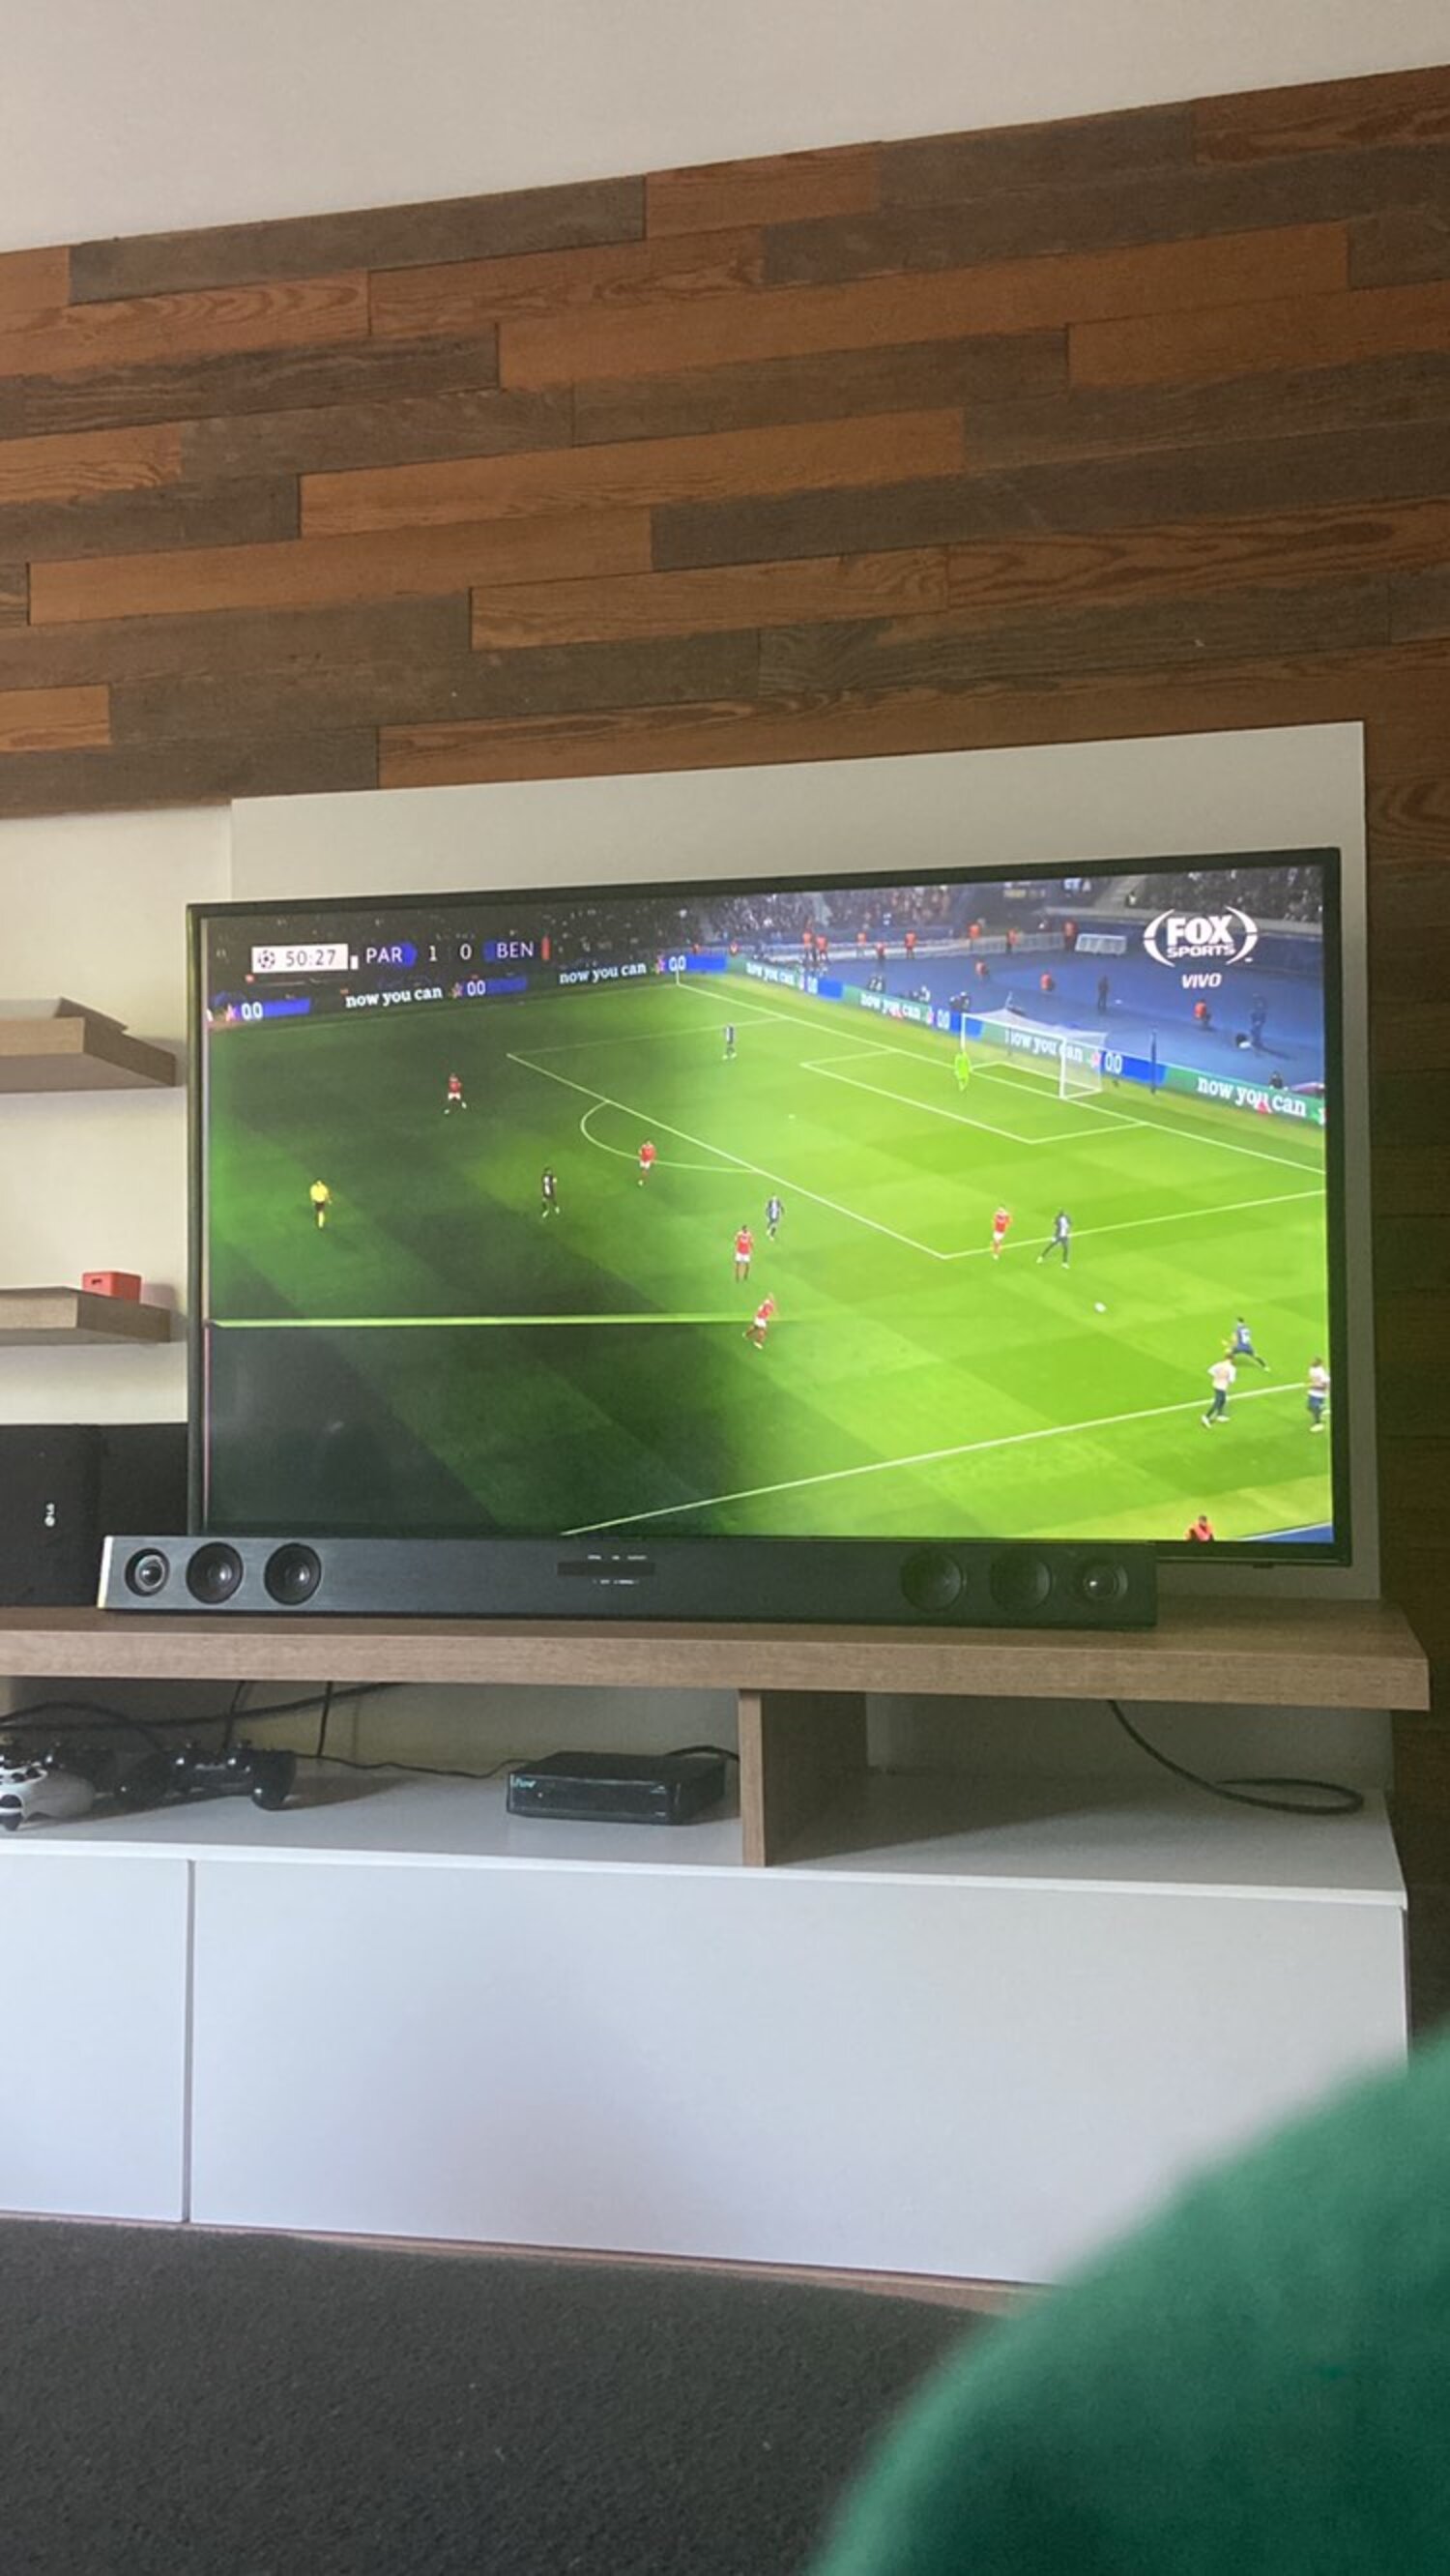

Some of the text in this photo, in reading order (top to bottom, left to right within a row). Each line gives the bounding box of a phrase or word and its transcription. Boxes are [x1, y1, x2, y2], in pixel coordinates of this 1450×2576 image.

[1167, 915, 1233, 945] FOX
[285, 942, 534, 968] 50:27 PAR 1 0 BEN
[1167, 944, 1235, 958] SPORTS
[560, 962, 647, 984] now you can
[1181, 972, 1222, 989] VIVO
[345, 986, 442, 1008] now you can
[1198, 1077, 1306, 1118] now you can
